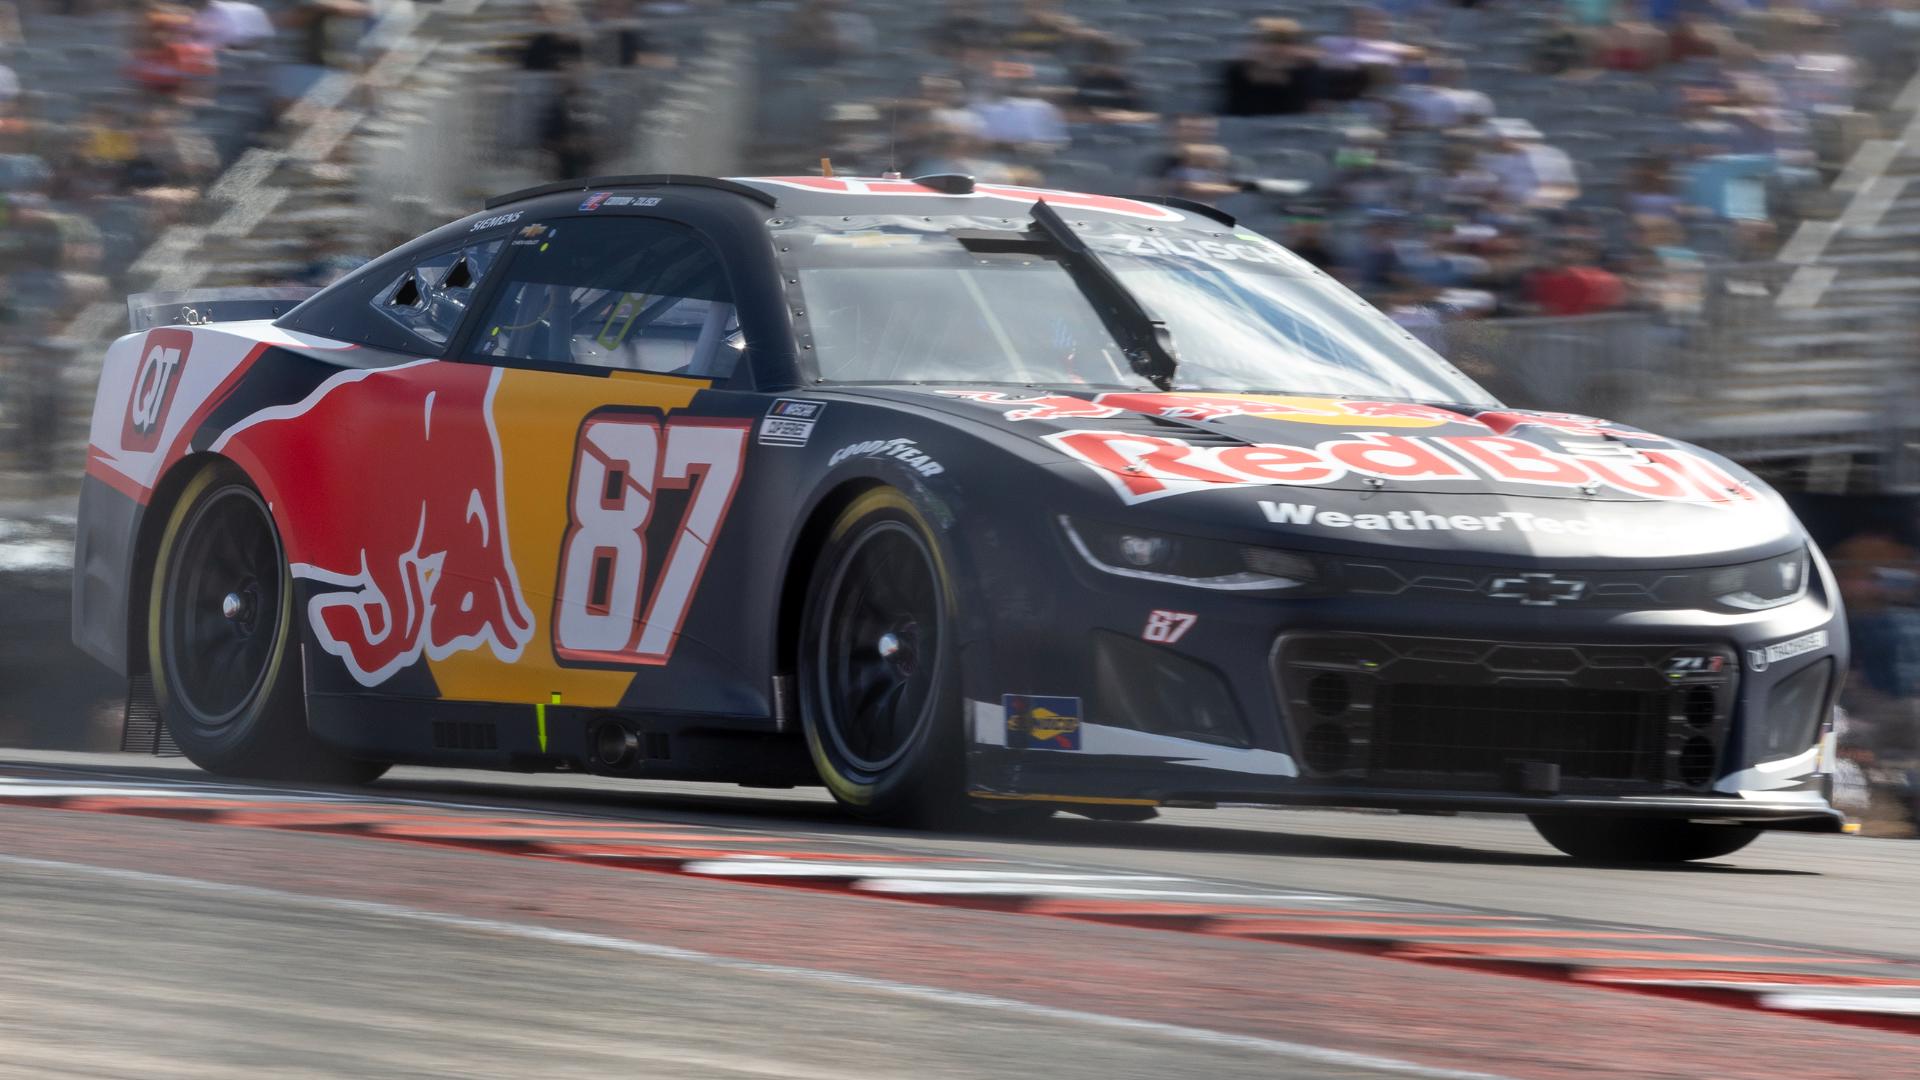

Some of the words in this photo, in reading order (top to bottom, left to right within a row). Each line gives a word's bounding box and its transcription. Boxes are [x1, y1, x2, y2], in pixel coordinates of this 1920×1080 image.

[469, 210, 524, 232] SIEMENS
[132, 344, 181, 432] QT
[828, 437, 945, 477] GOODYEAR
[1044, 431, 1478, 504] Red
[554, 413, 753, 665] 87
[1142, 609, 1199, 644] 87
